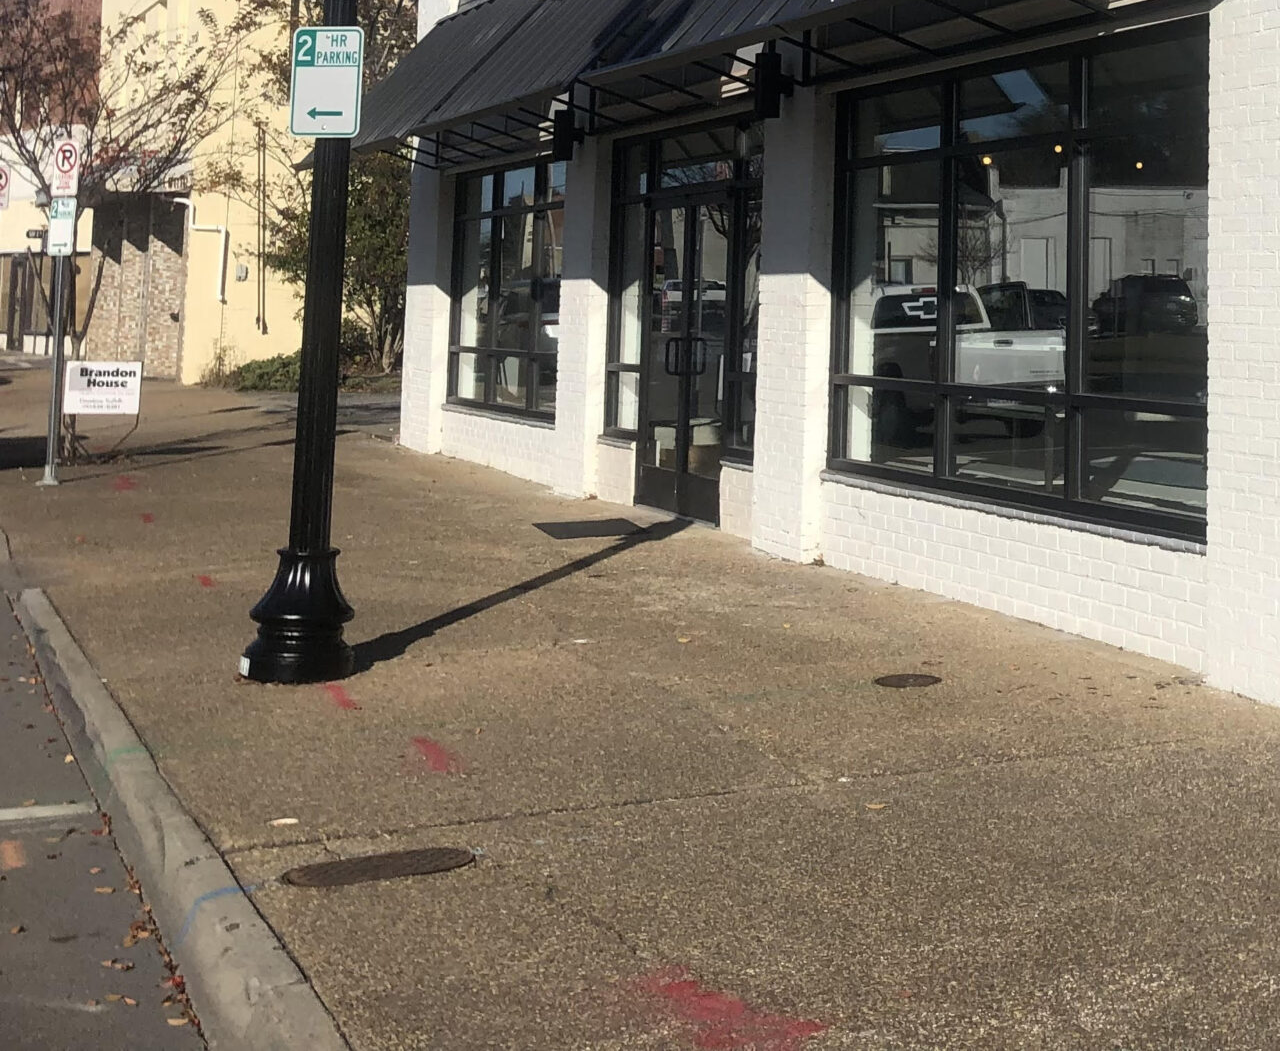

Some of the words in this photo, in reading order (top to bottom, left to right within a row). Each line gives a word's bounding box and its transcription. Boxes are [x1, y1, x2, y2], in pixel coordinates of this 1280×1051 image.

[330, 34, 348, 47] HR
[297, 35, 313, 61] 2
[316, 51, 358, 64] PARKING
[80, 367, 137, 378] Brandon
[87, 378, 128, 388] House
